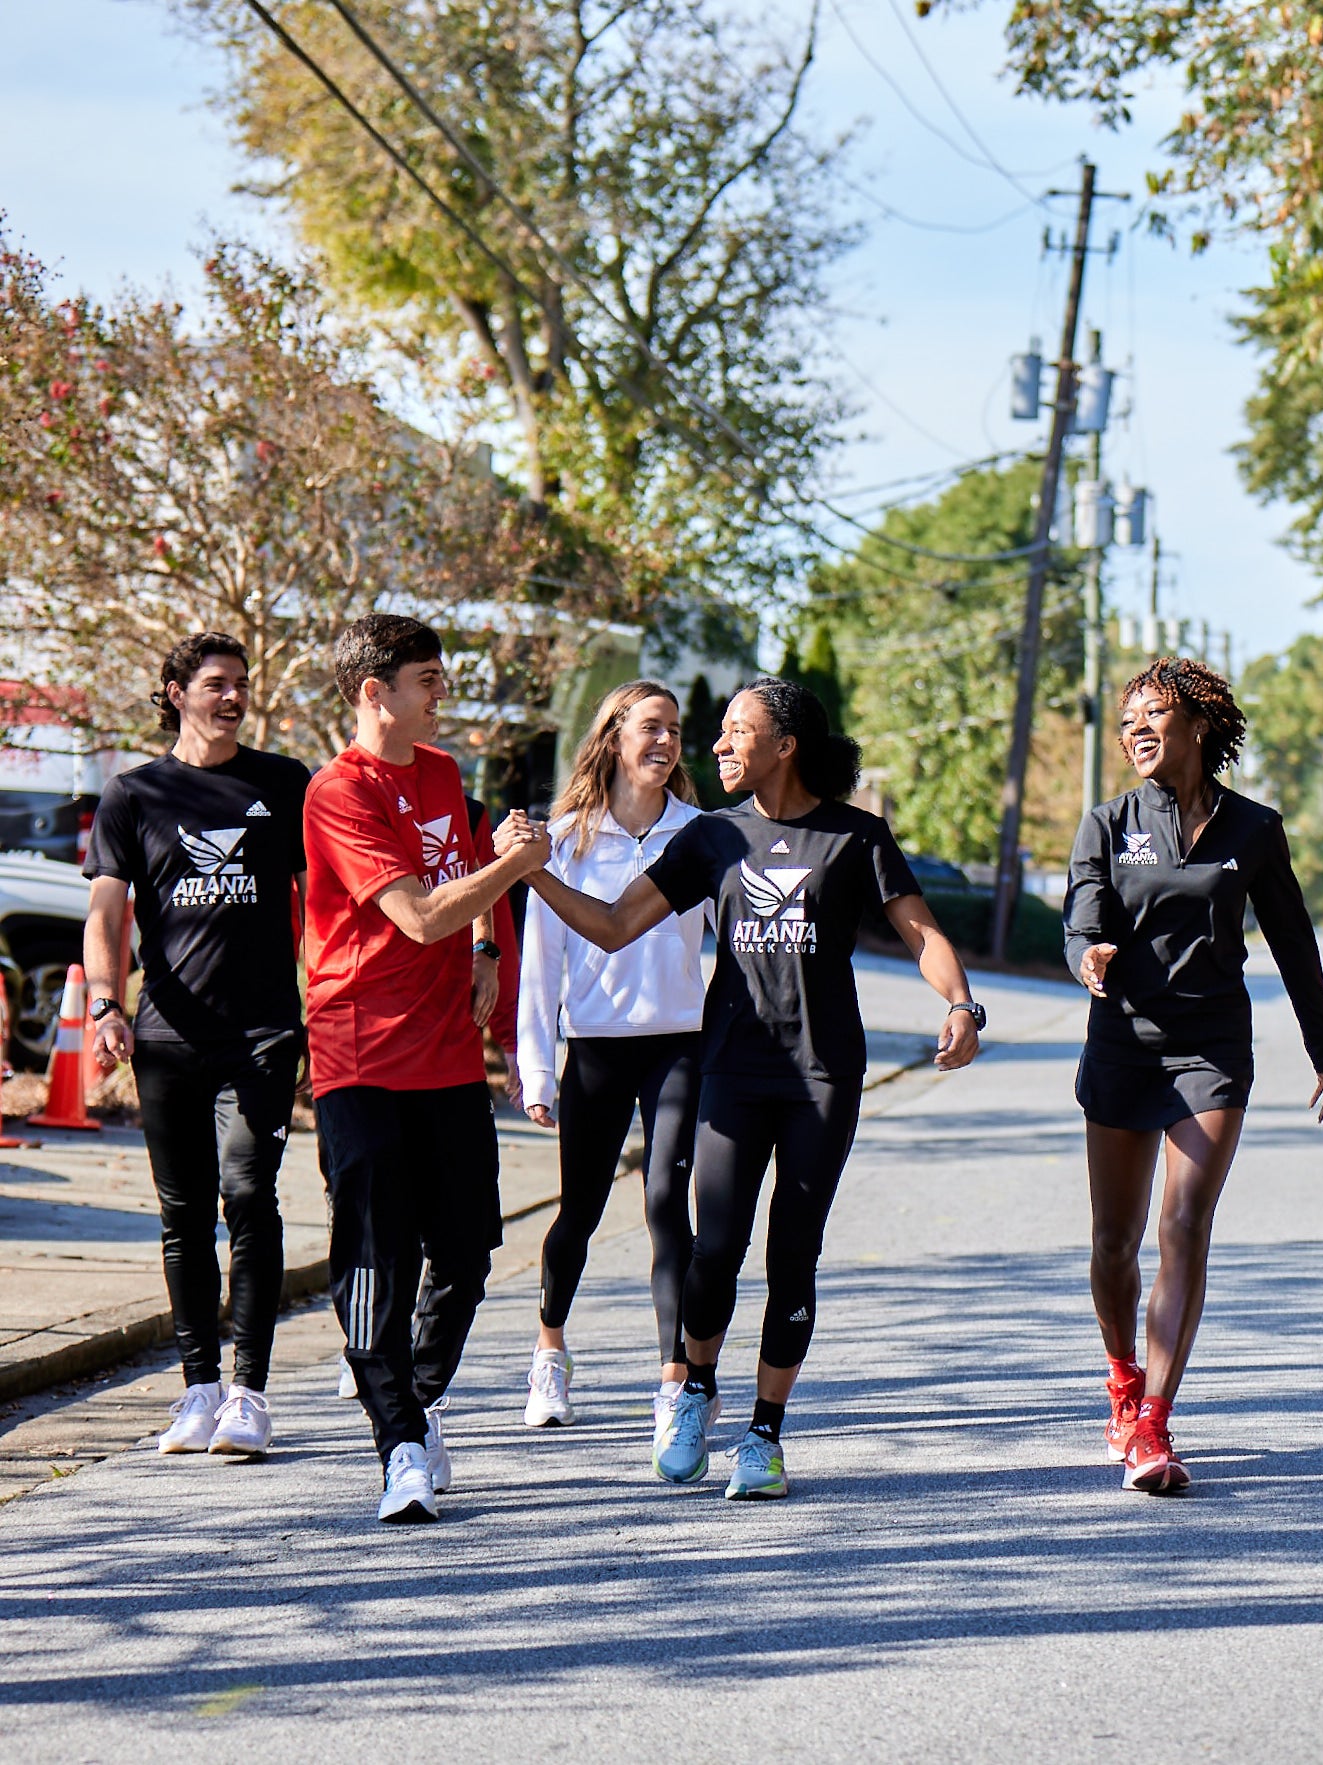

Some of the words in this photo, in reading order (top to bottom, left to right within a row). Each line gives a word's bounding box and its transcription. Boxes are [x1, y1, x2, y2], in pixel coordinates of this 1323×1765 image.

[1119, 852, 1157, 861] ATLANTA
[173, 876, 257, 897] ATLANTA
[172, 895, 217, 906] TRACK
[224, 895, 257, 903] CLUB
[733, 920, 817, 943] ATLANTA
[733, 942, 776, 953] TRACK
[785, 942, 816, 953] CLUB
